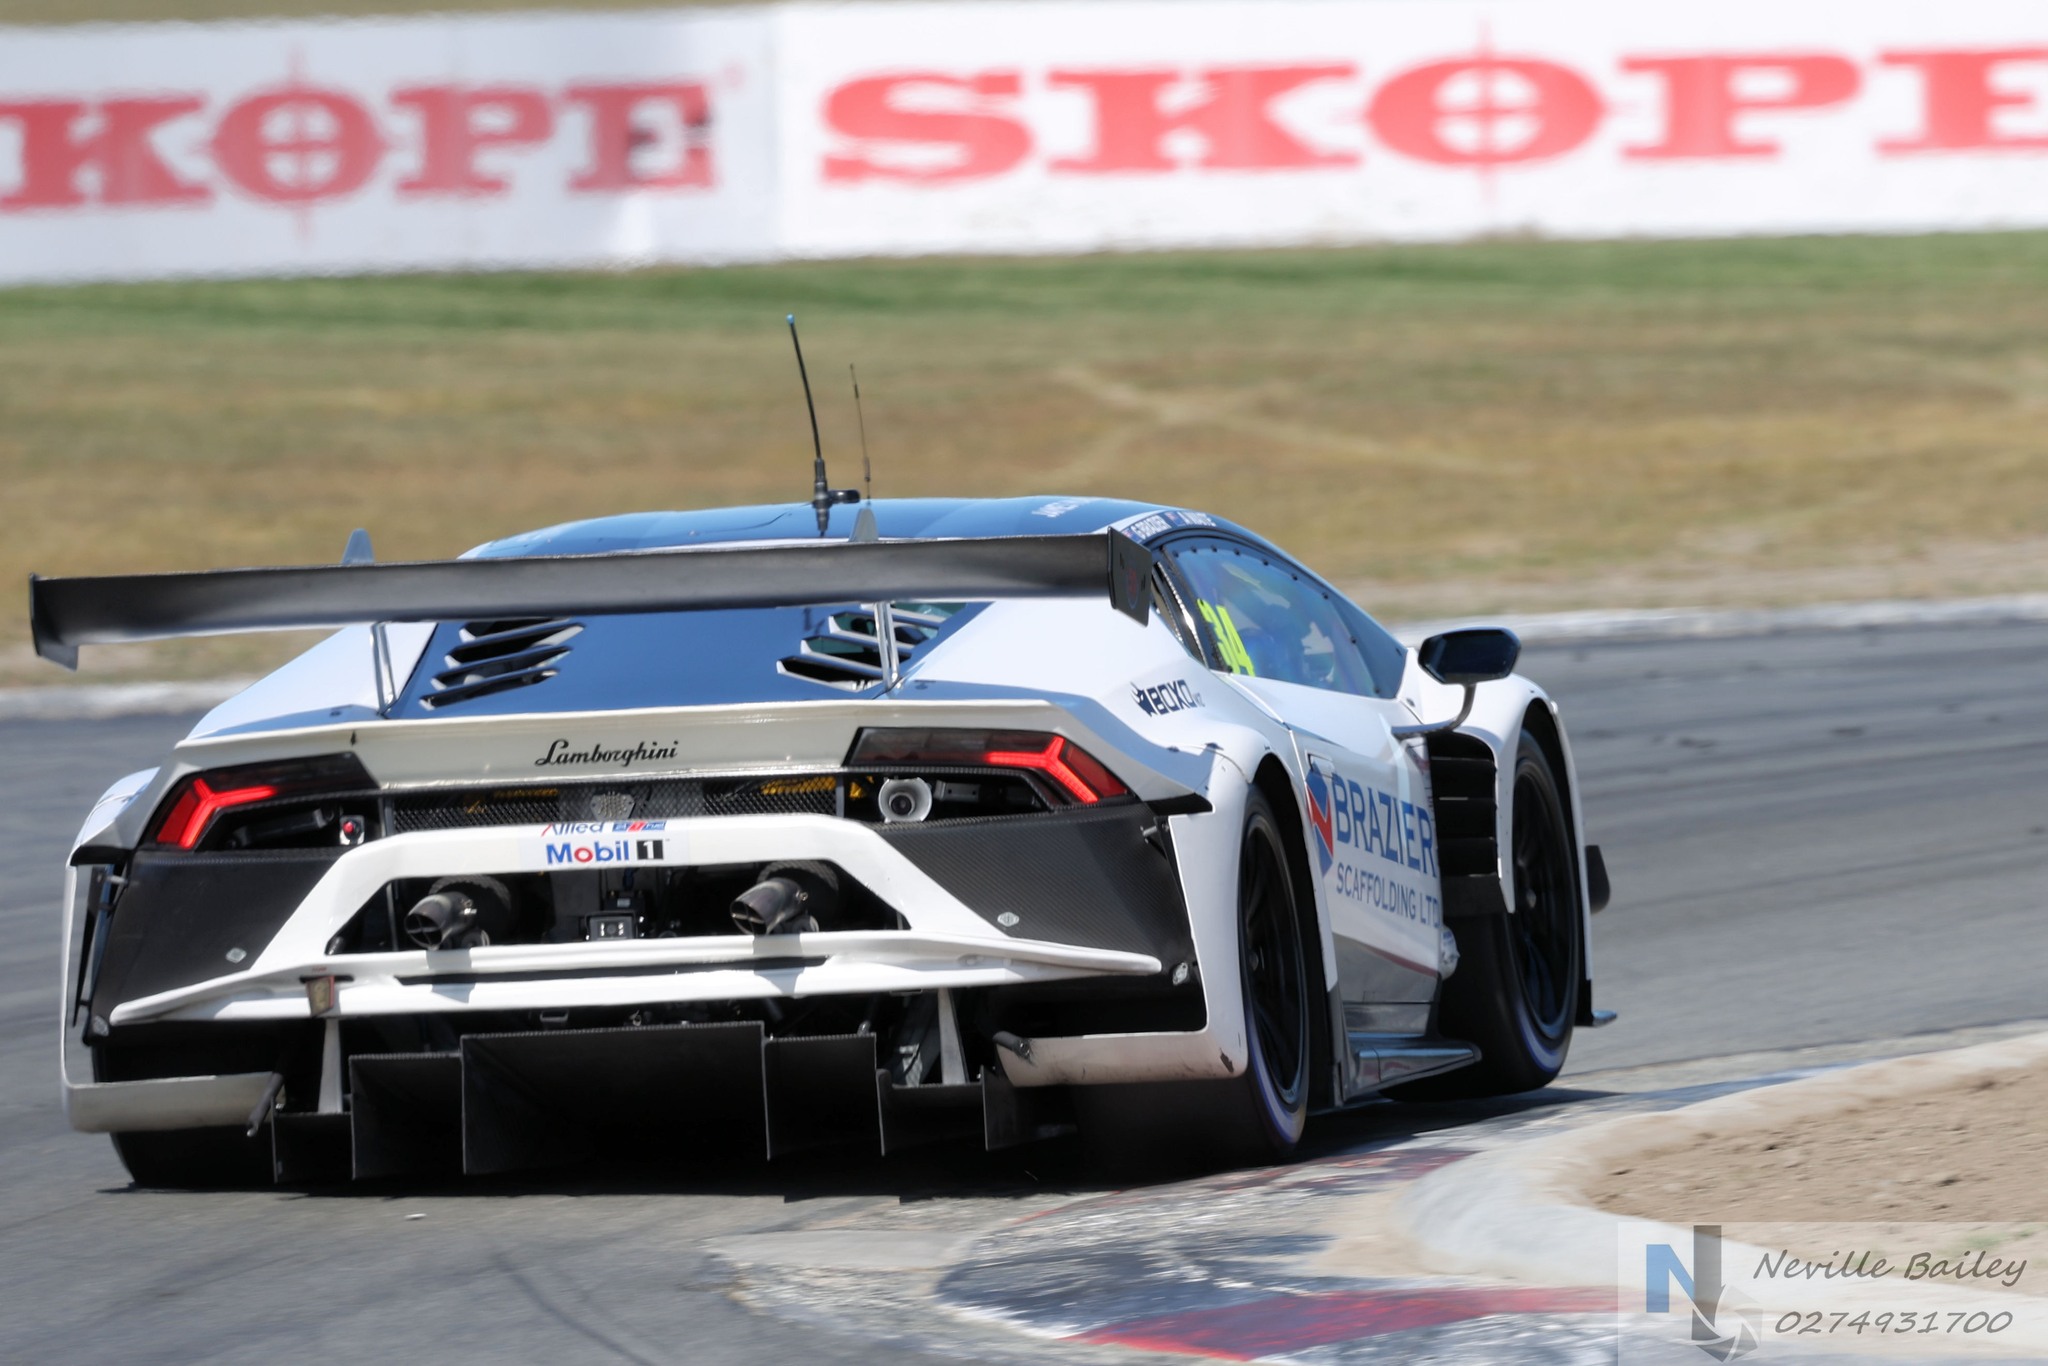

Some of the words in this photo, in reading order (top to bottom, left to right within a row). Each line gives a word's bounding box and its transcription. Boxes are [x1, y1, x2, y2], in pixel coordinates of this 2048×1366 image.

[822, 45, 2048, 188] SKOPE
[1146, 679, 1198, 715] BOXO
[535, 739, 679, 767] Lamborghini
[541, 821, 606, 837] Allied
[1332, 772, 1437, 877] BRAZIER
[546, 840, 630, 865] Mobil
[1336, 862, 1416, 920] SCAFFOLDING
[1420, 894, 1441, 928] LTD
